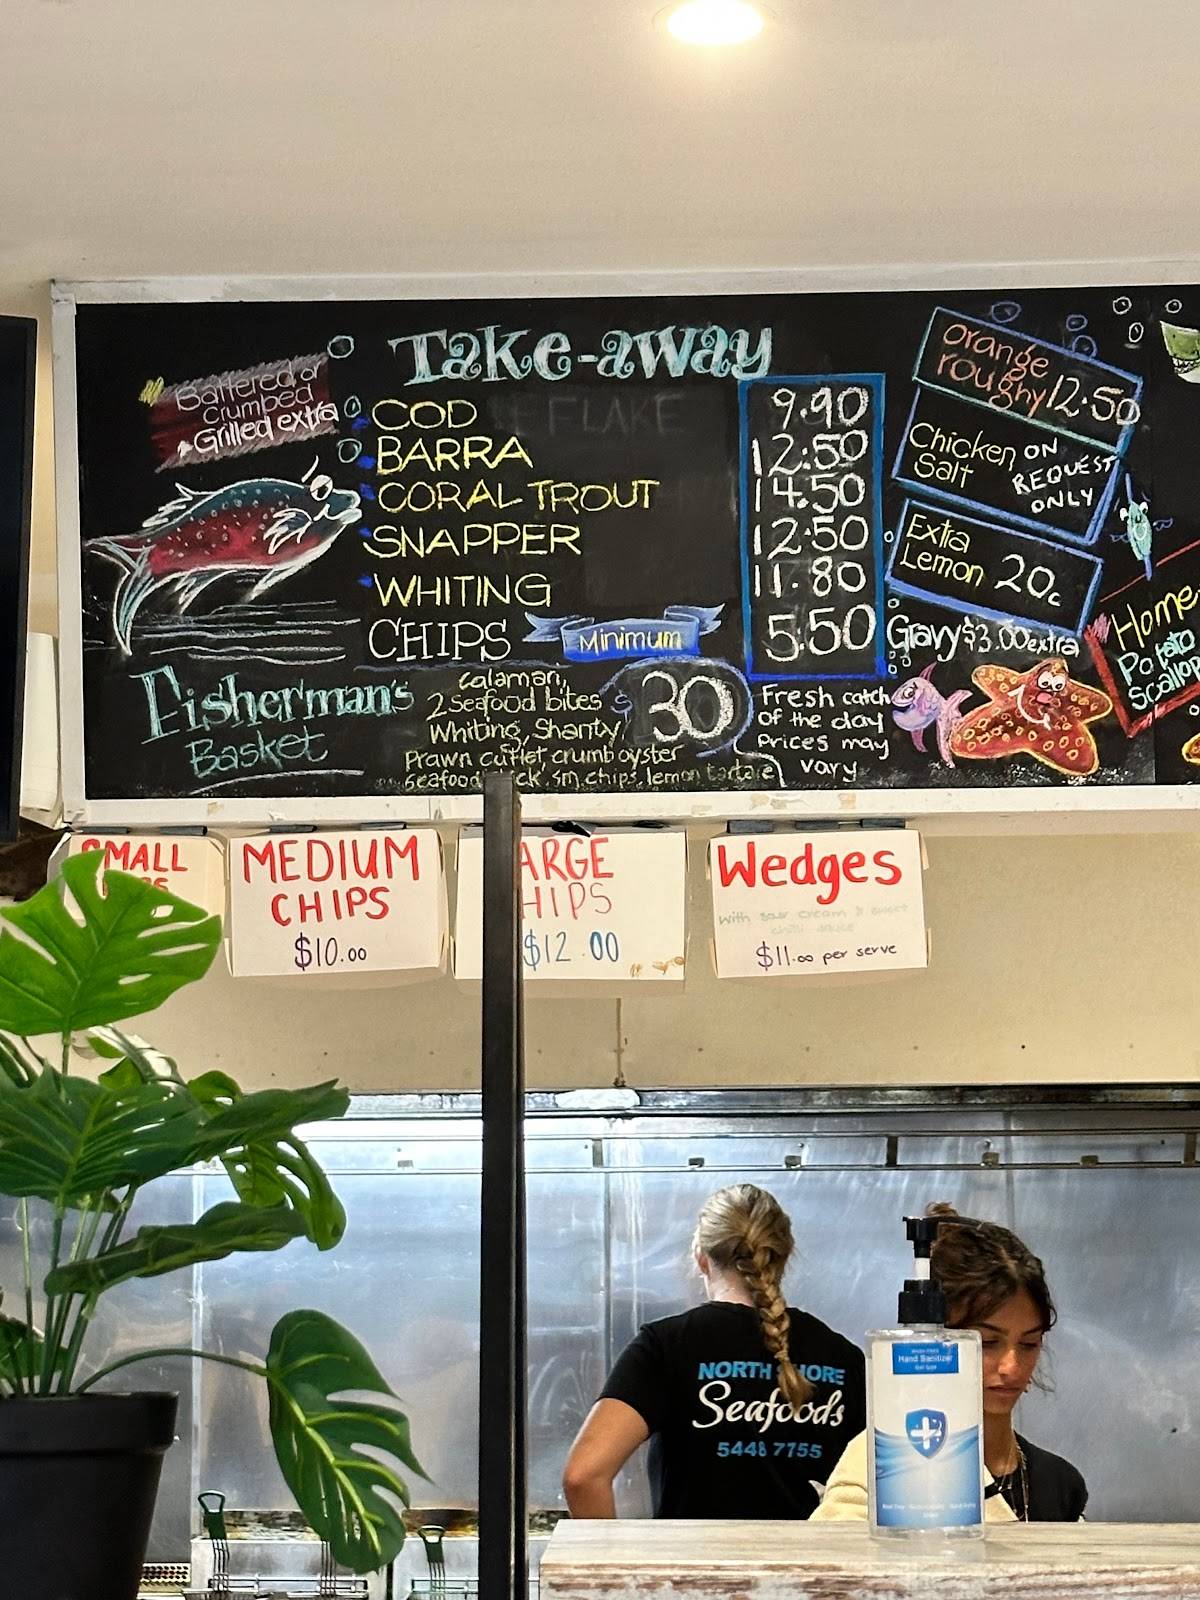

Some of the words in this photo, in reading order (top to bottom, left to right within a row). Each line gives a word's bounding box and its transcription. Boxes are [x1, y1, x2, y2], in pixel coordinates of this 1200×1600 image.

[387, 325, 772, 386] Take-away
[175, 359, 297, 411] Battered
[300, 361, 321, 381] or
[372, 400, 478, 430] COD
[771, 386, 869, 430] 9.90
[194, 416, 273, 454] Grilled
[909, 423, 1016, 471] Chicken
[1024, 437, 1058, 460] ON
[376, 436, 533, 475] BARRA
[914, 453, 974, 488] Salt
[1012, 455, 1118, 494] REQUEST
[378, 479, 523, 512] CORAL
[528, 479, 660, 514] TROUT
[755, 472, 866, 514] 14.50
[1032, 488, 1093, 513] ONLY
[363, 523, 581, 558] SNAPPER
[754, 556, 867, 598] 11.80
[900, 543, 985, 587] Lemon
[374, 573, 551, 608] WHITING
[368, 618, 512, 661] CHIPS
[579, 626, 682, 652] Minimum
[887, 615, 962, 664] Gravy
[545, 685, 602, 712] bites
[762, 684, 834, 708] Fresh
[842, 686, 891, 706] catch
[790, 711, 821, 728] the
[831, 711, 884, 733] day
[185, 725, 328, 778] Basket
[405, 750, 473, 772] Prawn
[552, 745, 614, 764] crumb
[618, 743, 684, 770] oyster
[842, 738, 889, 760] may
[800, 758, 857, 782] vary
[243, 835, 420, 884] MEDIUM
[518, 837, 614, 881] ARGE
[717, 841, 903, 905] Wedges
[271, 886, 391, 927] CHIPS
[520, 882, 612, 920] HIPS
[294, 933, 367, 971] $10.00
[823, 950, 848, 965] per
[856, 944, 897, 957] serve
[698, 1361, 772, 1380] NORTH
[692, 1380, 845, 1433] Seafoods
[717, 1441, 767, 1458] 5448
